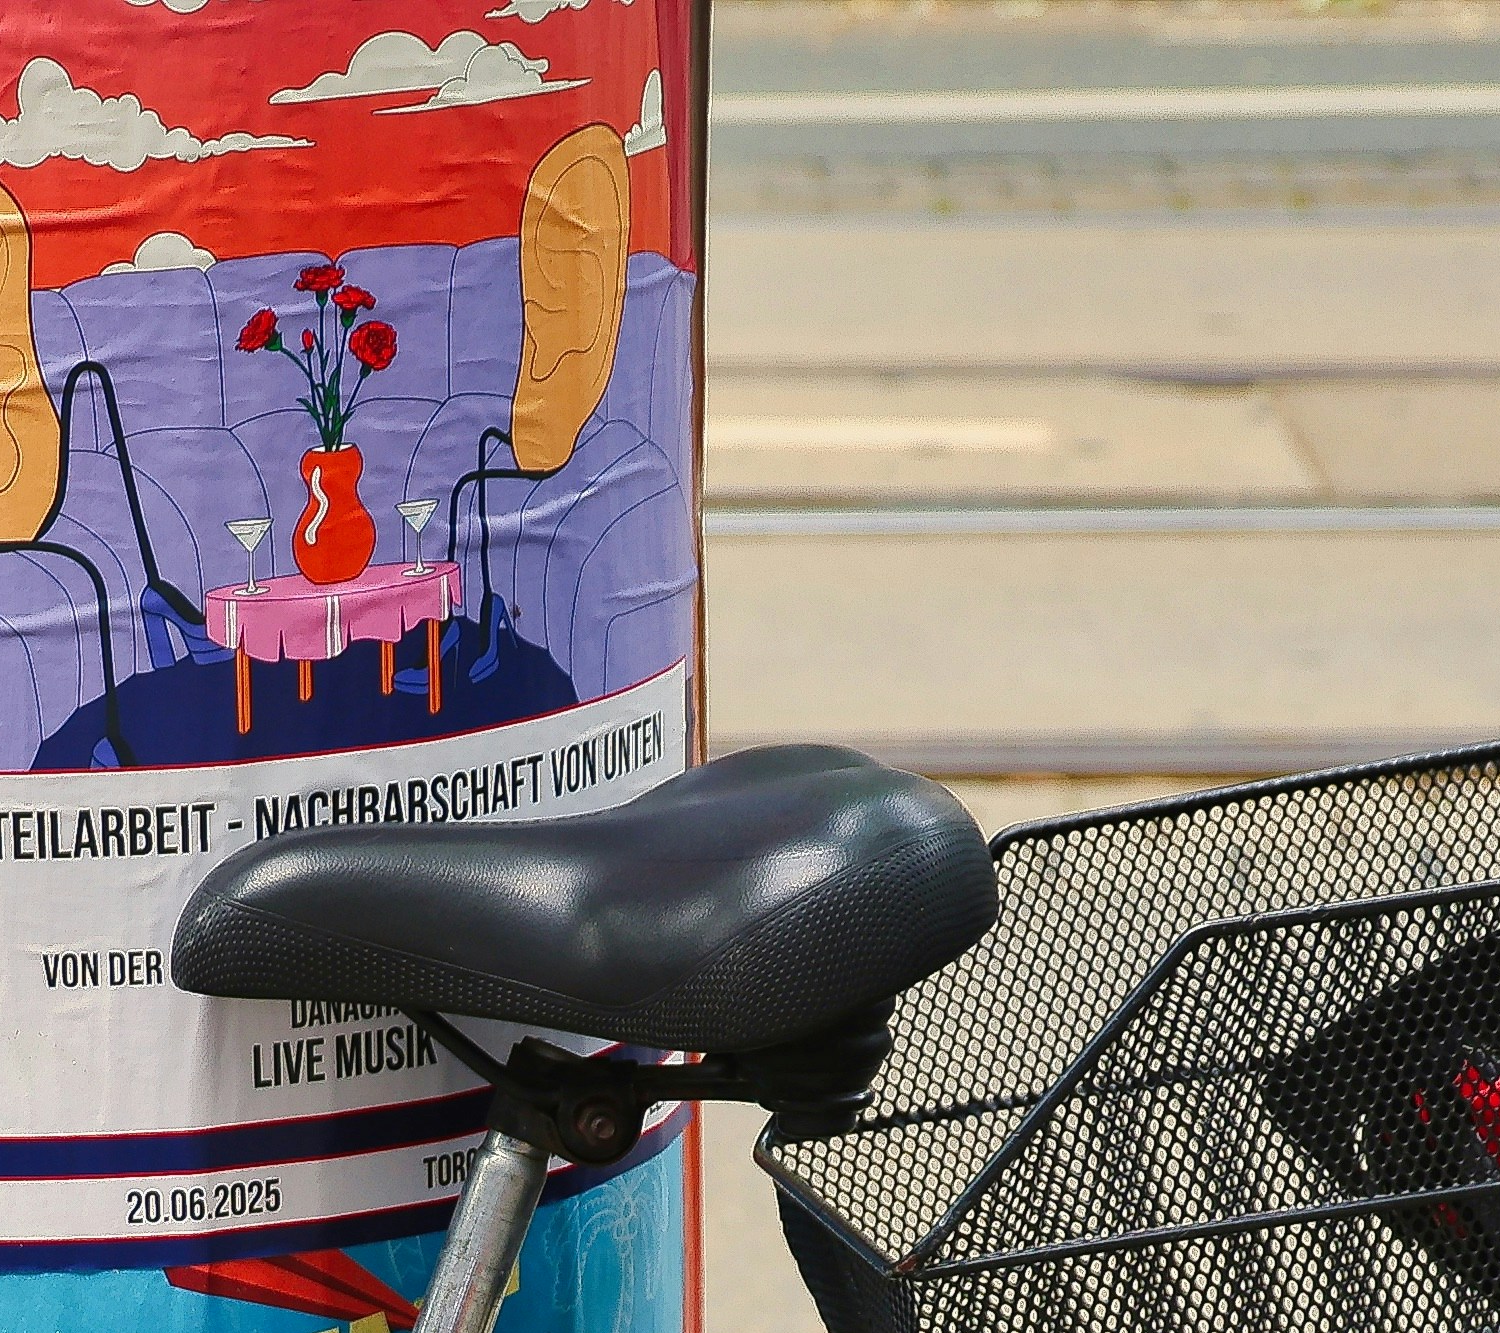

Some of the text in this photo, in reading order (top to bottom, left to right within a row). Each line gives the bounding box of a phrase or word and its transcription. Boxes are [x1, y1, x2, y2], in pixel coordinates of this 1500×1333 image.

[255, 752, 544, 842] NACHBARSCHAFT
[549, 737, 599, 798] VON
[602, 708, 665, 780] UNTEN
[42, 948, 164, 989] VON DER
[252, 1023, 438, 1089] LIVE MUSIK
[126, 1177, 284, 1226] 20.06.2025
